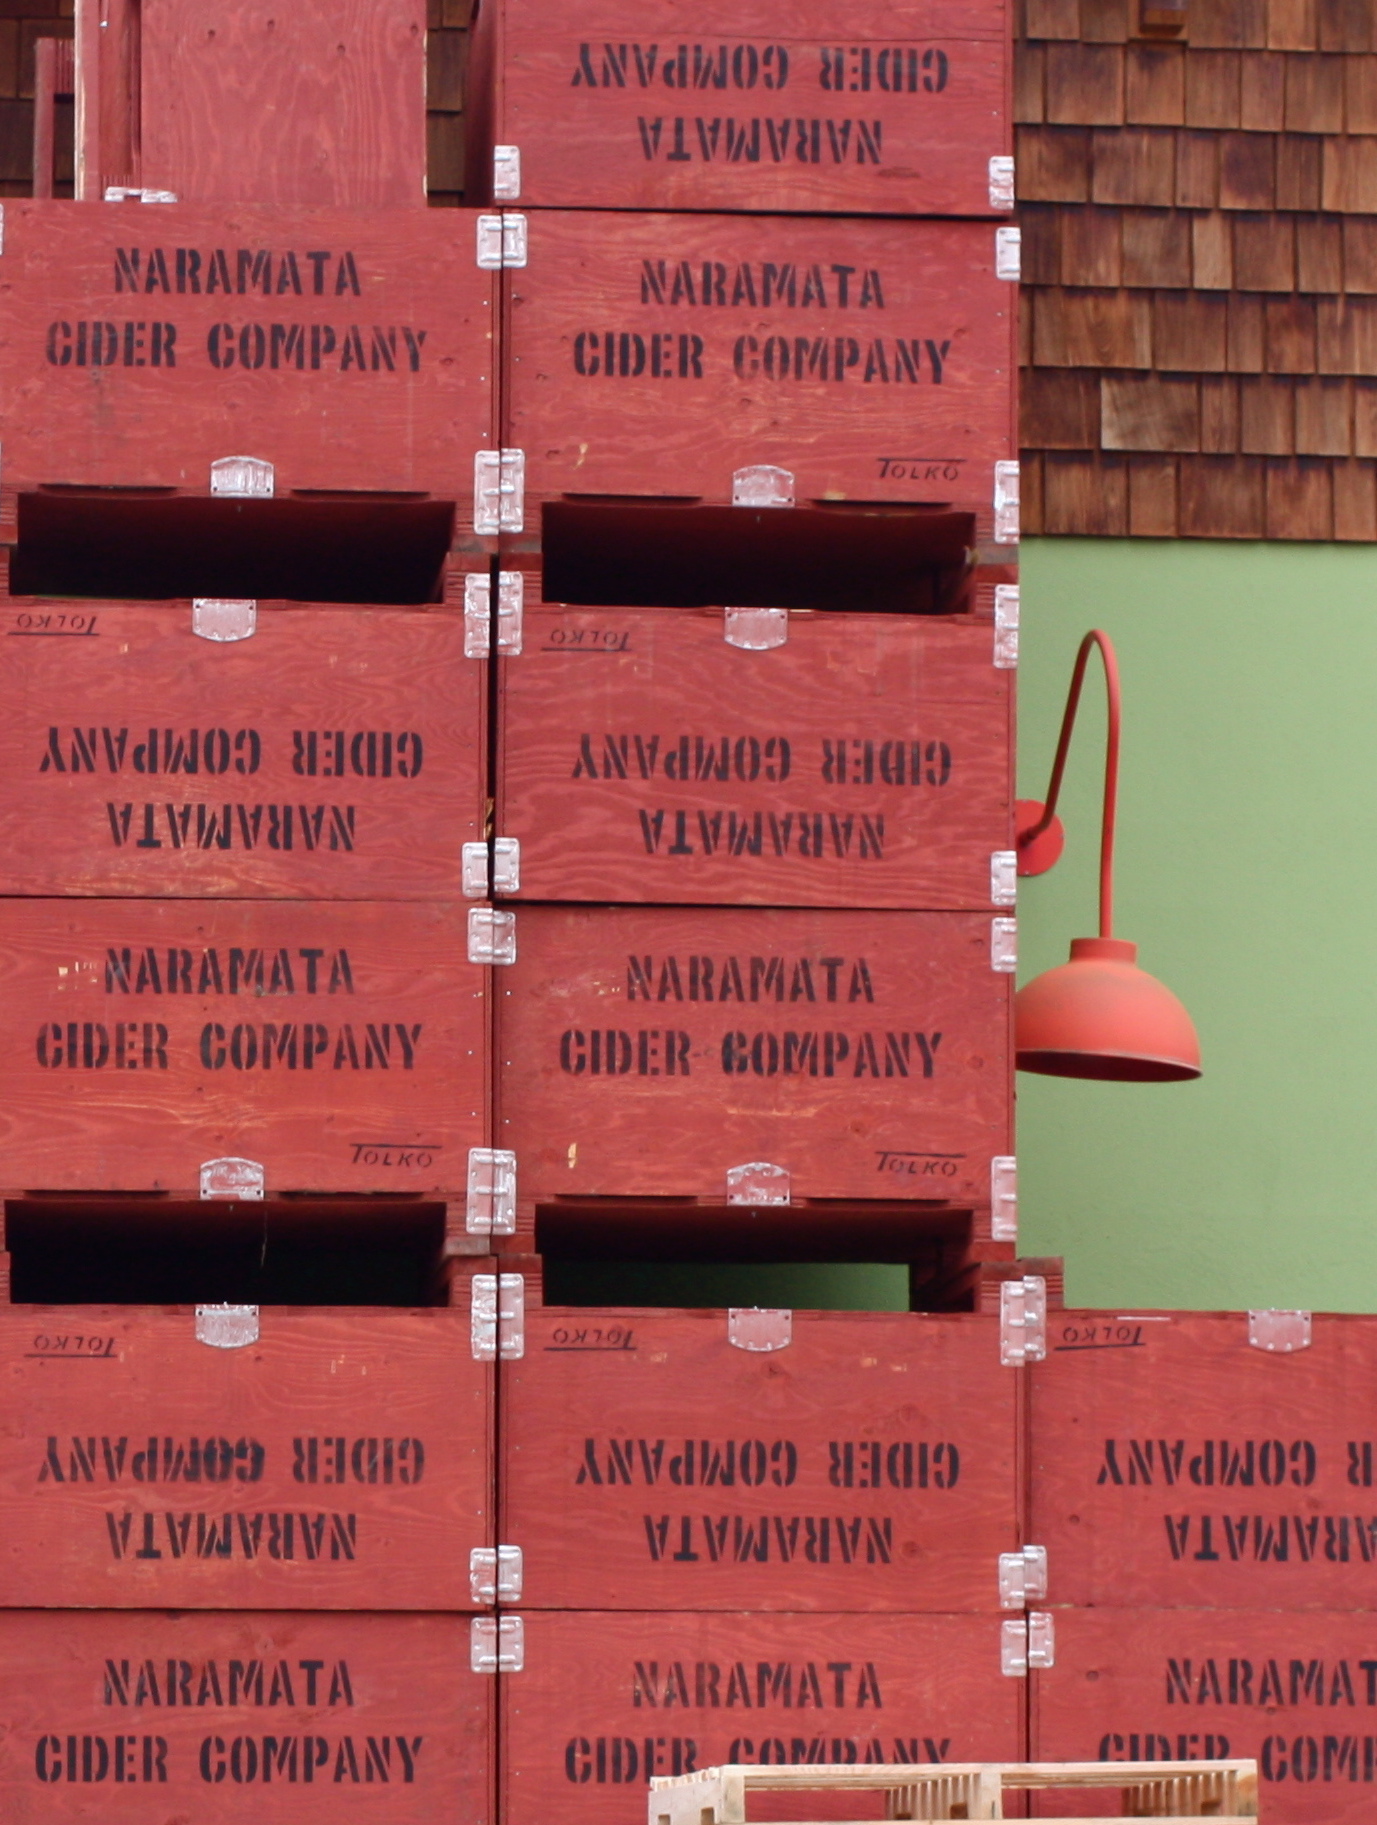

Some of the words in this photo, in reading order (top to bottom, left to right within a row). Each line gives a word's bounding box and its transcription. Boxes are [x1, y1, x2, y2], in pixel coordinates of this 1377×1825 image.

[572, 43, 788, 88] COMPANY
[820, 48, 948, 92] CIDER
[638, 117, 881, 164] NARAMATA
[115, 248, 360, 295] NARAMATA
[642, 261, 884, 308] NARAMATA
[47, 322, 176, 366] CIDER
[207, 324, 426, 371] COMPANY
[574, 333, 703, 378] CIDER
[734, 337, 950, 384] COMPANY
[877, 457, 966, 481] TOLKO
[7, 614, 99, 636] TOLKO
[541, 629, 632, 652] TOLKO
[40, 728, 260, 774] COMPANY
[293, 731, 422, 777] CIDER
[573, 734, 790, 781] COMPANY
[822, 740, 951, 785] CIDER
[108, 803, 354, 851] NARAMATA
[639, 810, 884, 858] NARAMATA
[105, 948, 352, 994] NARAMATA
[628, 956, 874, 1002] NARAMATA
[37, 1023, 167, 1069] CIDER
[200, 1024, 421, 1069] COMPANY
[560, 1030, 690, 1075] CIDER
[722, 1032, 941, 1077] COMPANY
[350, 1143, 442, 1167] TOLKO
[876, 1151, 966, 1176] TOLKO
[24, 1336, 117, 1358] TOLKO
[544, 1329, 637, 1352] TOLKO
[1054, 1327, 1145, 1351] TOLKO
[40, 1437, 265, 1482] COMPANY
[293, 1438, 424, 1483] CIDER
[576, 1439, 797, 1486] COMPANY
[830, 1442, 959, 1488] CIDER
[1098, 1440, 1316, 1486] COMPANY
[107, 1513, 356, 1560] NARAMATA
[645, 1516, 891, 1563] NARAMATA
[105, 1660, 353, 1706] NARAMATA
[634, 1662, 882, 1708] NARAMATA
[36, 1736, 167, 1782] CIDER
[200, 1737, 422, 1782] COMPANY
[565, 1737, 698, 1784] CIDER
